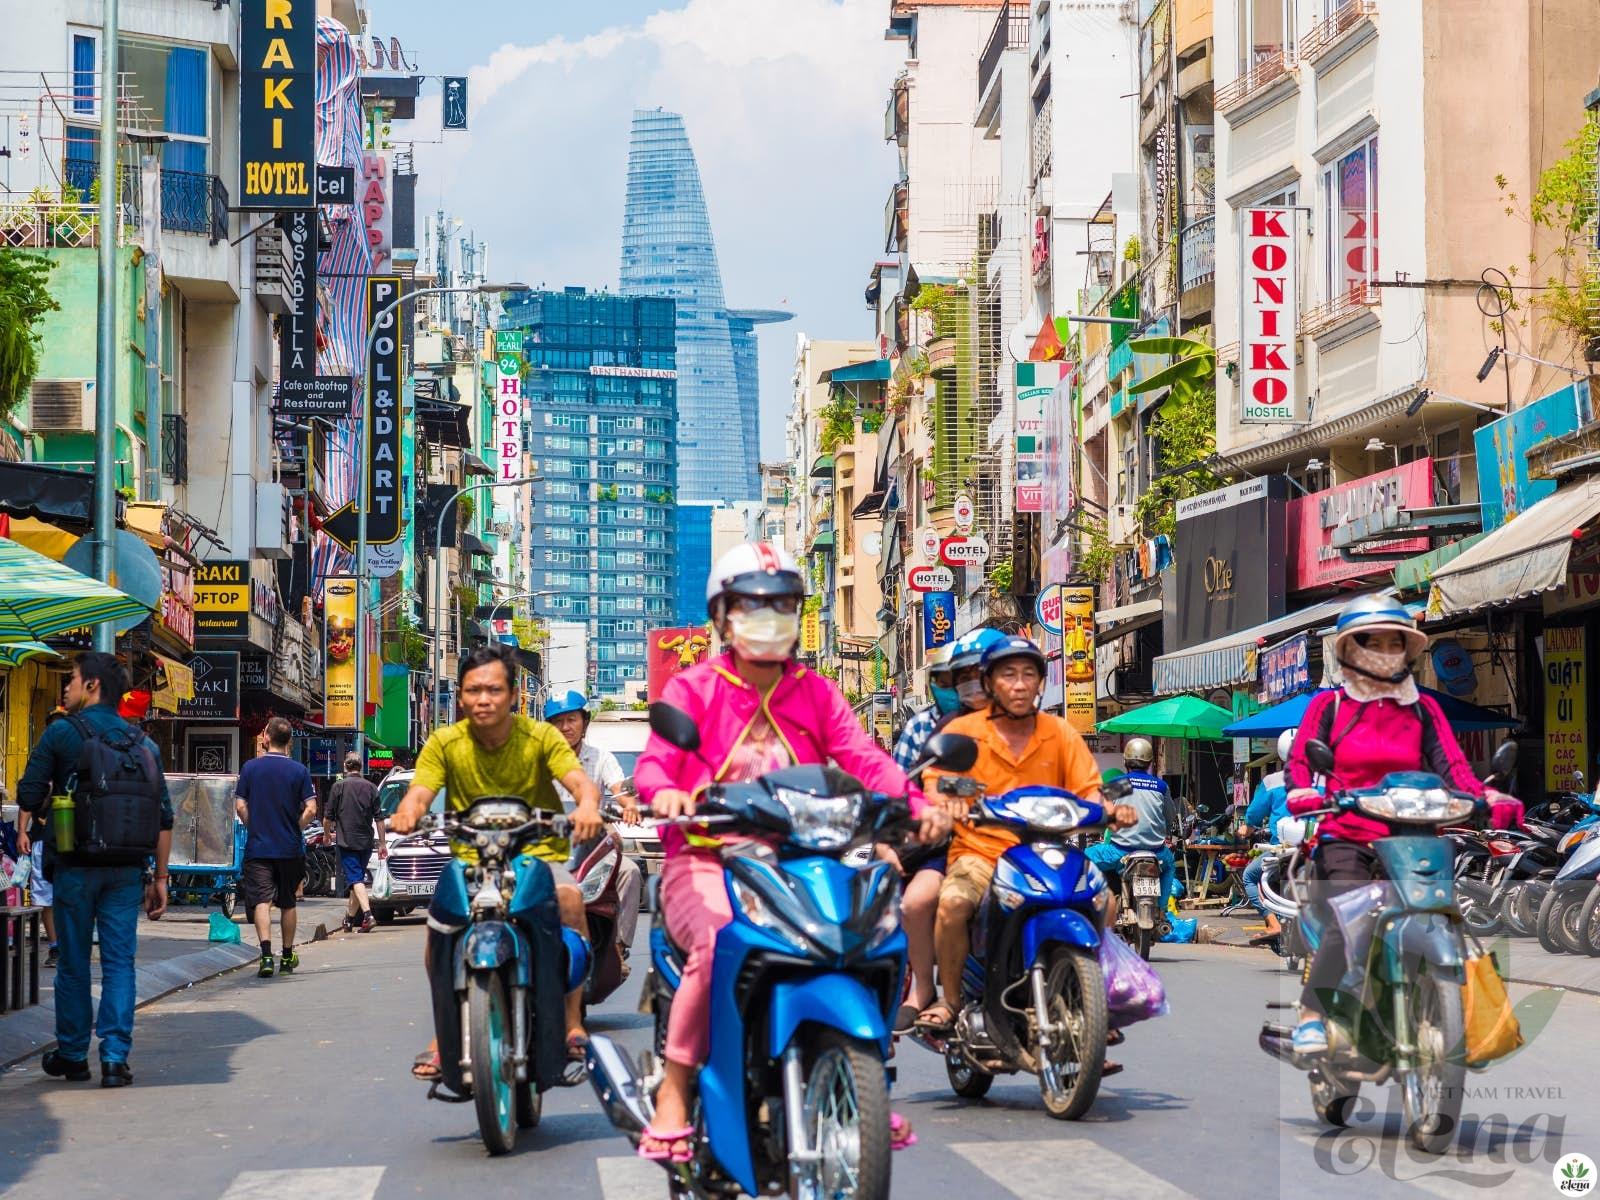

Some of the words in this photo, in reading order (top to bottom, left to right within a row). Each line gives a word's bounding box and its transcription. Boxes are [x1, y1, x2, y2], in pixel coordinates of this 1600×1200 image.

[261, 0, 295, 149] RAKI
[245, 161, 309, 195] HOTEL
[318, 175, 345, 195] tel
[1248, 210, 1290, 405] KONIKO
[503, 332, 516, 342] VN
[497, 341, 521, 351] PEARL
[500, 358, 518, 371] 94
[283, 379, 302, 390] Cafe
[303, 382, 314, 391] on
[314, 380, 348, 394] Rooftop
[307, 391, 324, 399] and
[284, 398, 347, 409] Restaurant
[1246, 406, 1293, 418] HOSTEL
[501, 378, 519, 480] HOTEL
[948, 546, 986, 555] HOTEL
[916, 574, 951, 582] HOTEL
[1044, 606, 1060, 624] KI
[198, 619, 239, 628] restaurant
[931, 606, 951, 643] Tiger
[1546, 627, 1583, 651] LAUNDRY
[240, 661, 262, 673] TEL
[1547, 657, 1583, 690] GIẶT
[179, 697, 217, 706] HOTEL
